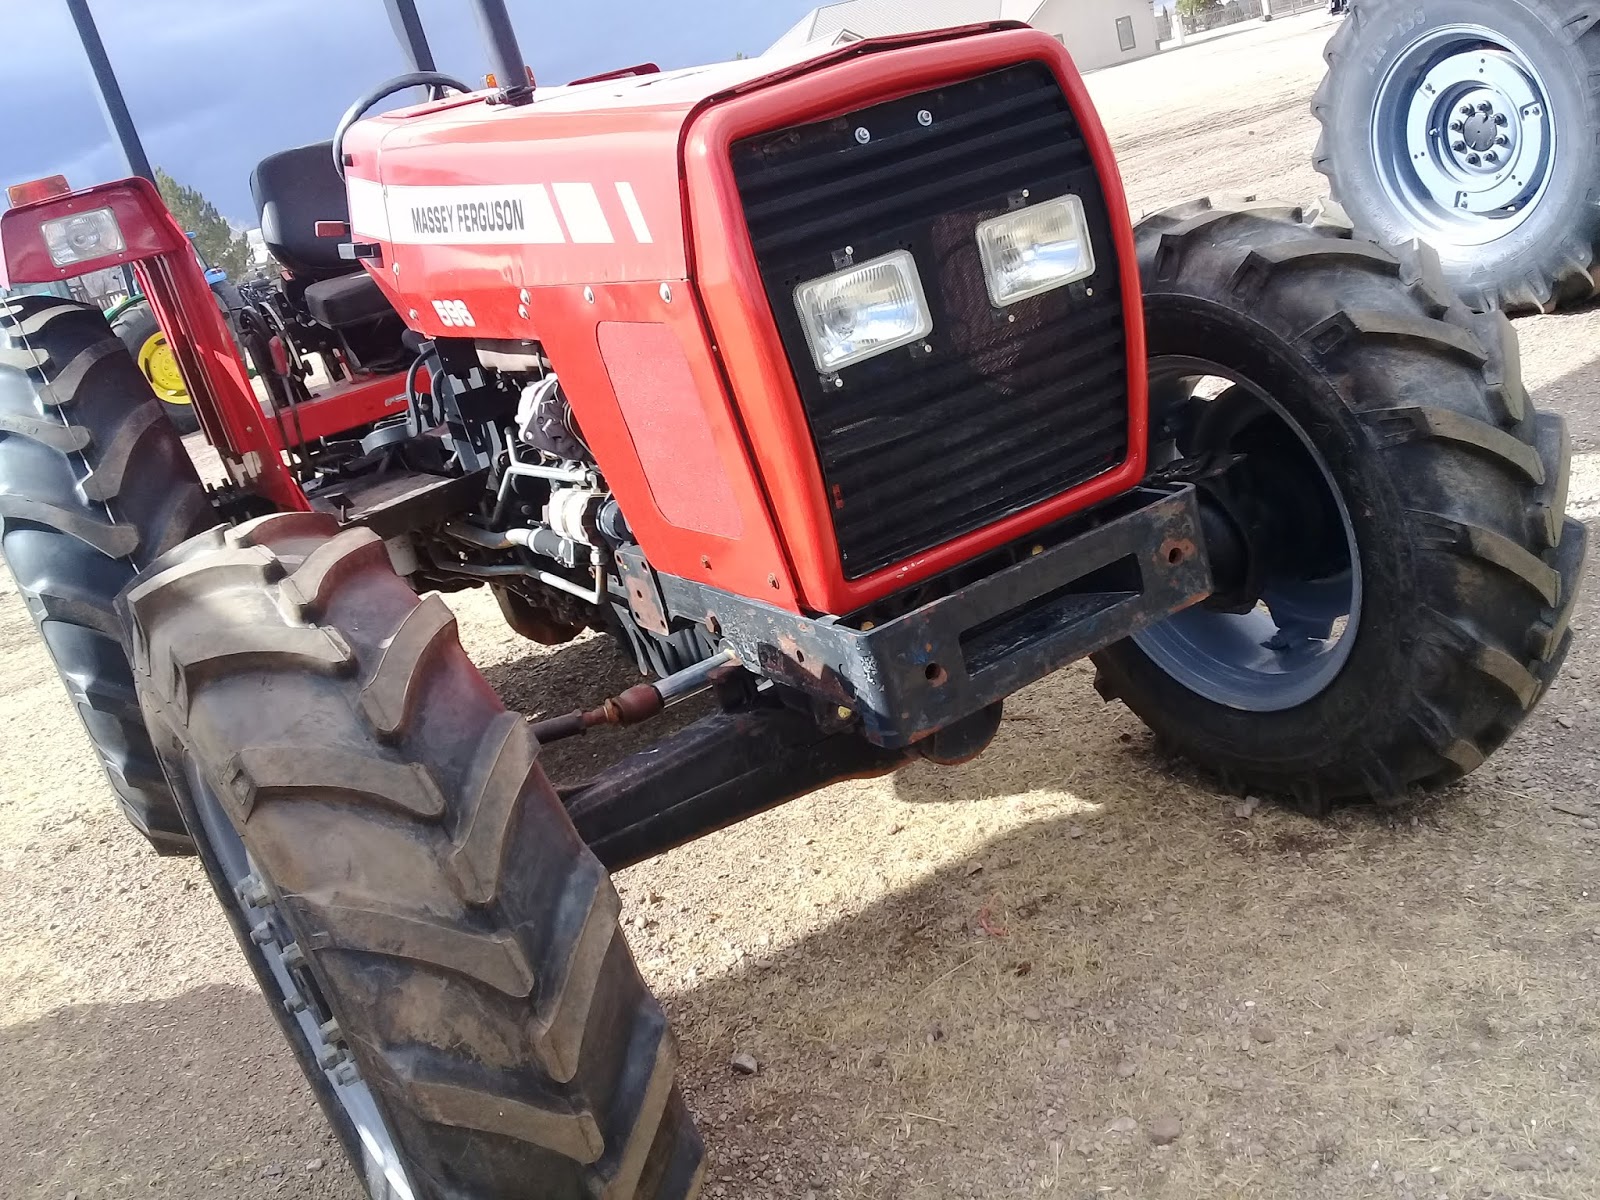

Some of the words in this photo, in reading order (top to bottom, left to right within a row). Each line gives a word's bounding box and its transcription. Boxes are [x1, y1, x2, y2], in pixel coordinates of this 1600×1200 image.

[411, 205, 454, 234] MASSEY
[456, 199, 525, 233] FERGUSON
[431, 299, 477, 328] 596
